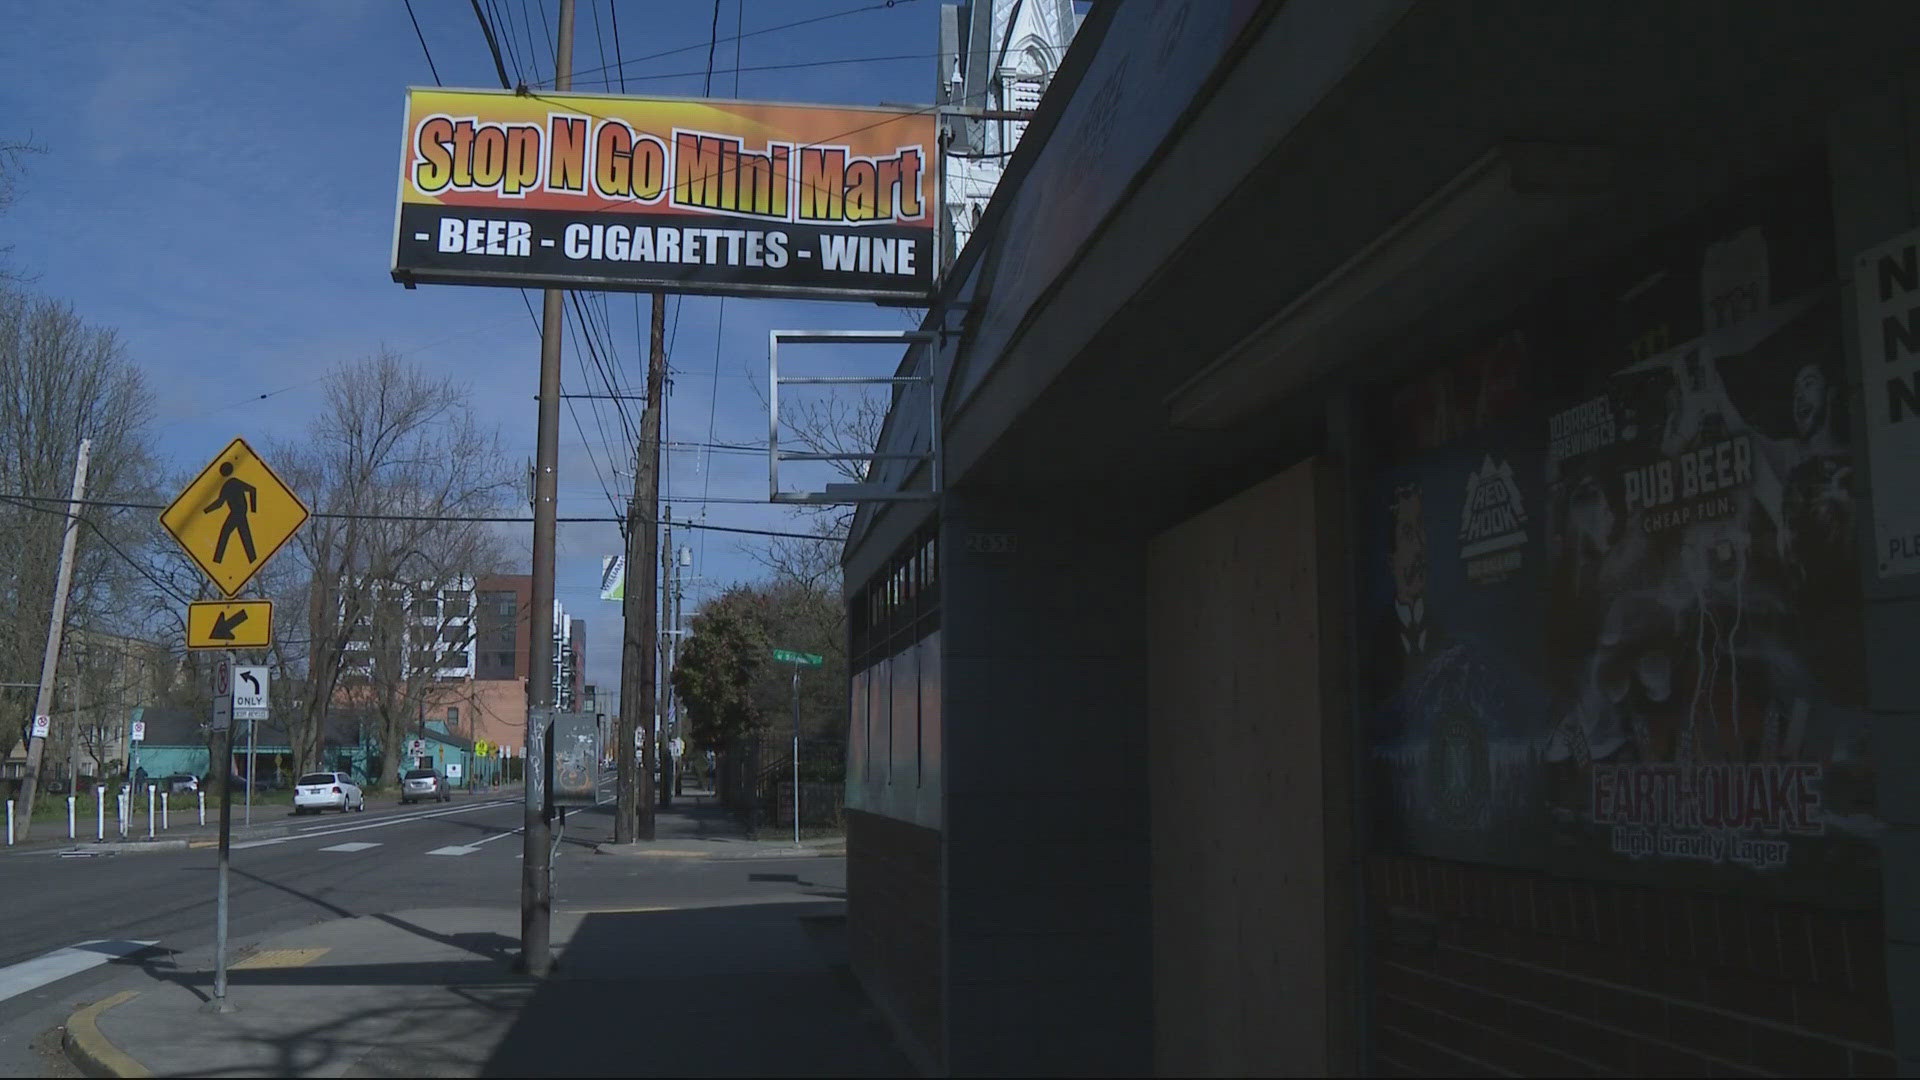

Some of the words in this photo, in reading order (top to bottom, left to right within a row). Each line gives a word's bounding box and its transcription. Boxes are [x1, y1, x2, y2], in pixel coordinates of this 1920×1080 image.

[412, 114, 545, 199] Stop
[544, 113, 591, 196] N
[590, 118, 669, 205] Go
[669, 127, 794, 224] Mini
[794, 144, 925, 226] Mart
[438, 217, 532, 257] BEER
[564, 223, 789, 269] CIGARETTES
[819, 234, 916, 275] WINE
[1623, 460, 1675, 511] PUB
[1679, 436, 1752, 498] BEER
[1466, 502, 1519, 542] HOOK
[1642, 507, 1690, 534] CHEAP
[1697, 497, 1736, 520] FUN.
[237, 697, 262, 706] ONLY
[1592, 762, 1824, 836] EARTHQUAKE
[1613, 827, 1655, 859] High
[1656, 831, 1724, 862] Gravity
[1729, 831, 1788, 868] Lager
